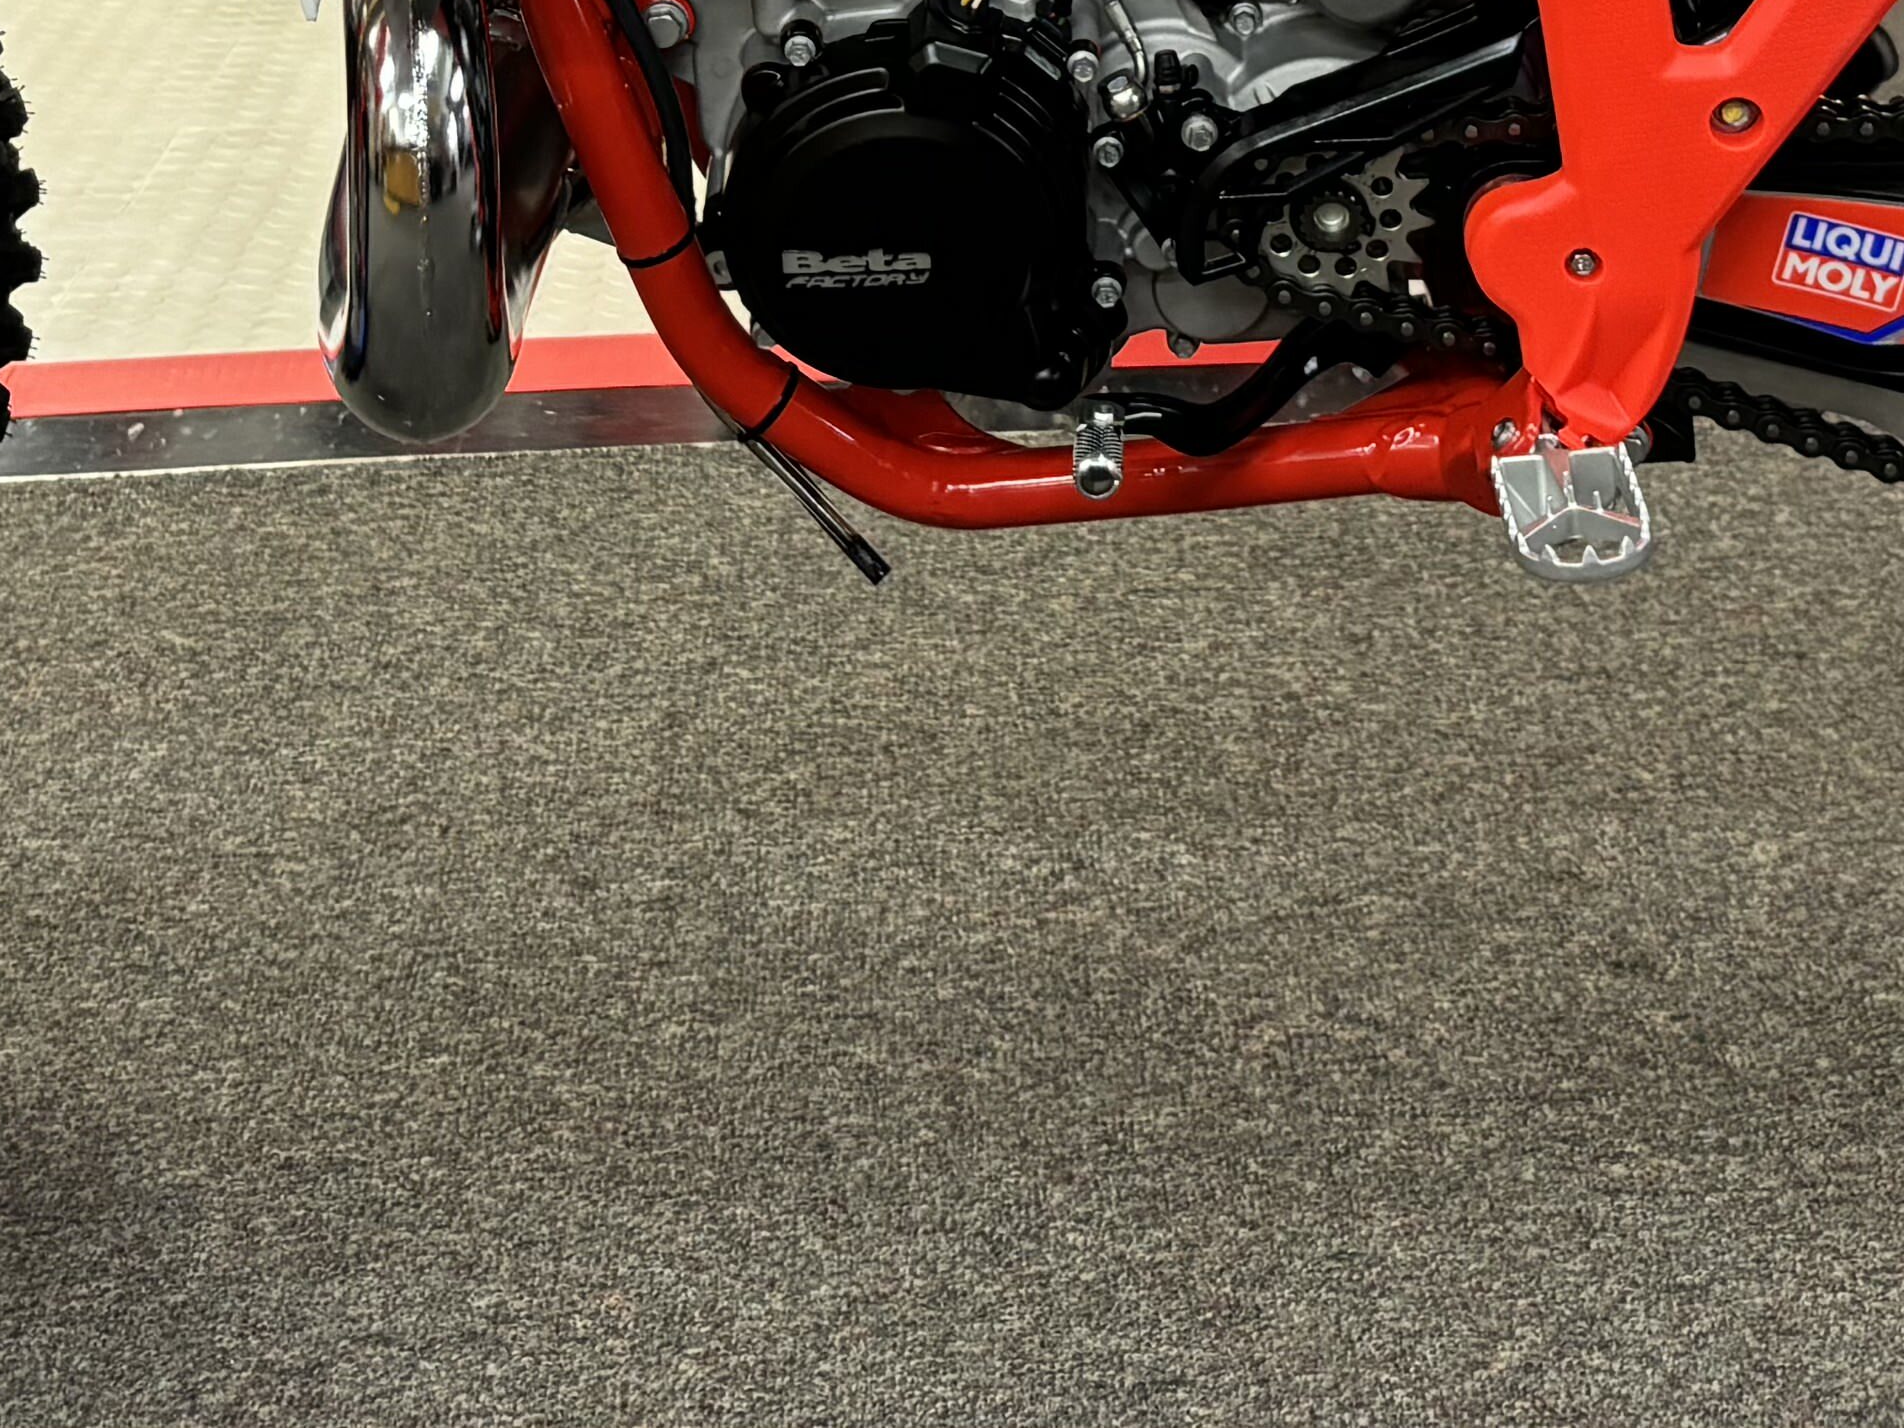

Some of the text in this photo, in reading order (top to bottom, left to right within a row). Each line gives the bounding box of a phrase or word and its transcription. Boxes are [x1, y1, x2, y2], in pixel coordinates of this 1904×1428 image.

[782, 247, 932, 275] Beta
[784, 272, 931, 289] FACTORY
[1778, 250, 1901, 307] MOLY
